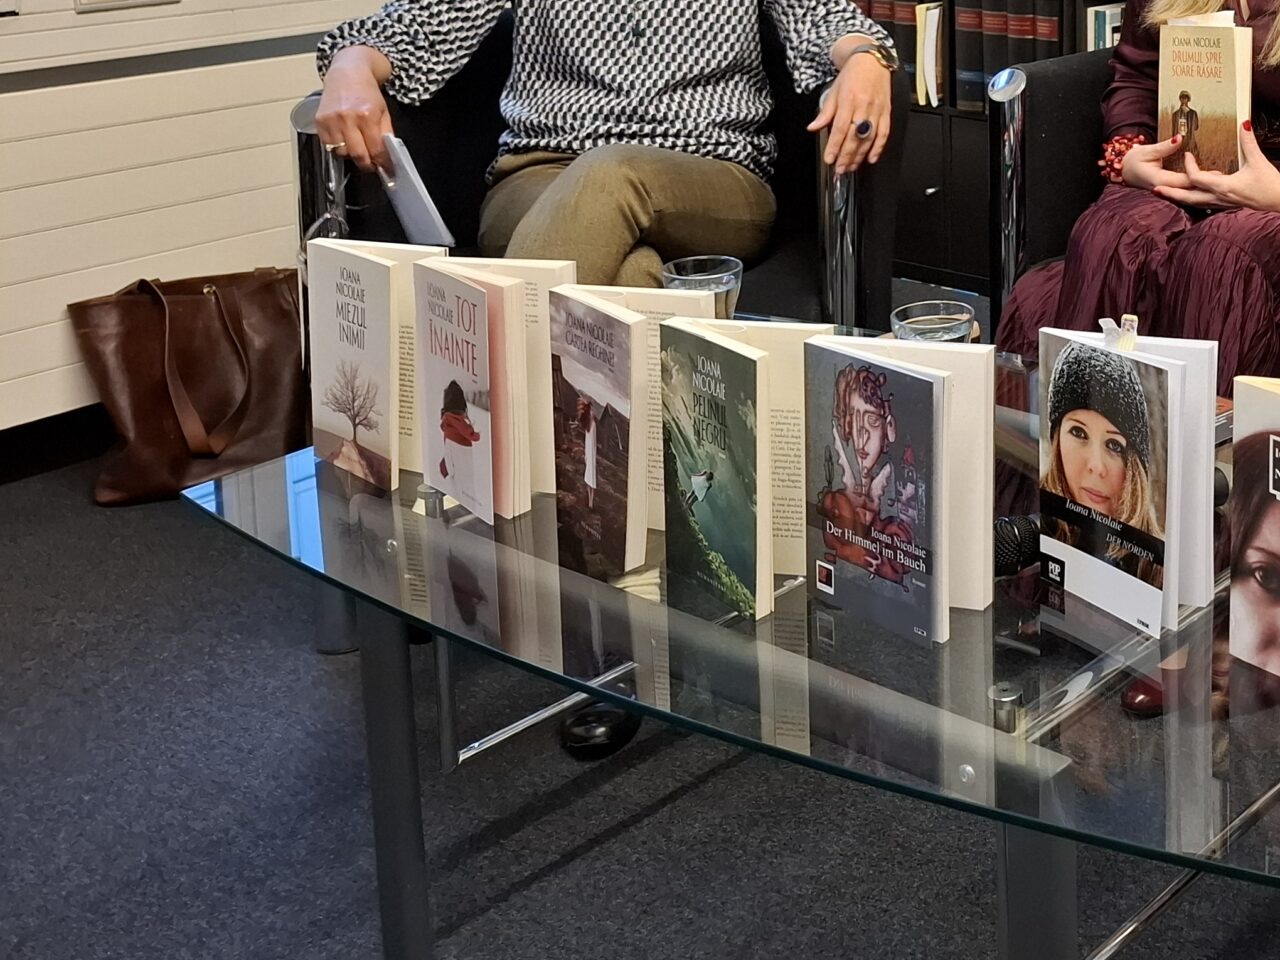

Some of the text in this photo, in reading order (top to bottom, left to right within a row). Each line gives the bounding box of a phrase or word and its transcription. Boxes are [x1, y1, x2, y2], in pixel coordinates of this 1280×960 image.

[1172, 36, 1222, 49] IOANA NICOLAIE
[1172, 50, 1223, 65] DRUMUL SPRE
[339, 266, 361, 284] IOANA
[335, 281, 366, 304] NICOLAIE
[427, 281, 446, 302] IOANA
[335, 300, 367, 330] MIEZUL
[427, 300, 454, 324] NICOLAIE
[455, 295, 478, 336] TOT
[338, 322, 366, 351] INIMII
[565, 311, 615, 349] IOANA NICOLAIE
[428, 318, 478, 377] ÎNAINTE
[565, 330, 615, 368] CARTEA REGHINEI
[697, 354, 722, 378] IOANA
[692, 372, 726, 401] NICOLAIE
[692, 392, 728, 429] PELINUL
[692, 416, 727, 452] NEGRU
[1065, 498, 1123, 532] Ioana Nicolaie
[826, 520, 927, 574] Der Himmel im Bauch
[871, 526, 927, 559] Ioana Nicolaie
[1106, 532, 1155, 563] DER NORDEN
